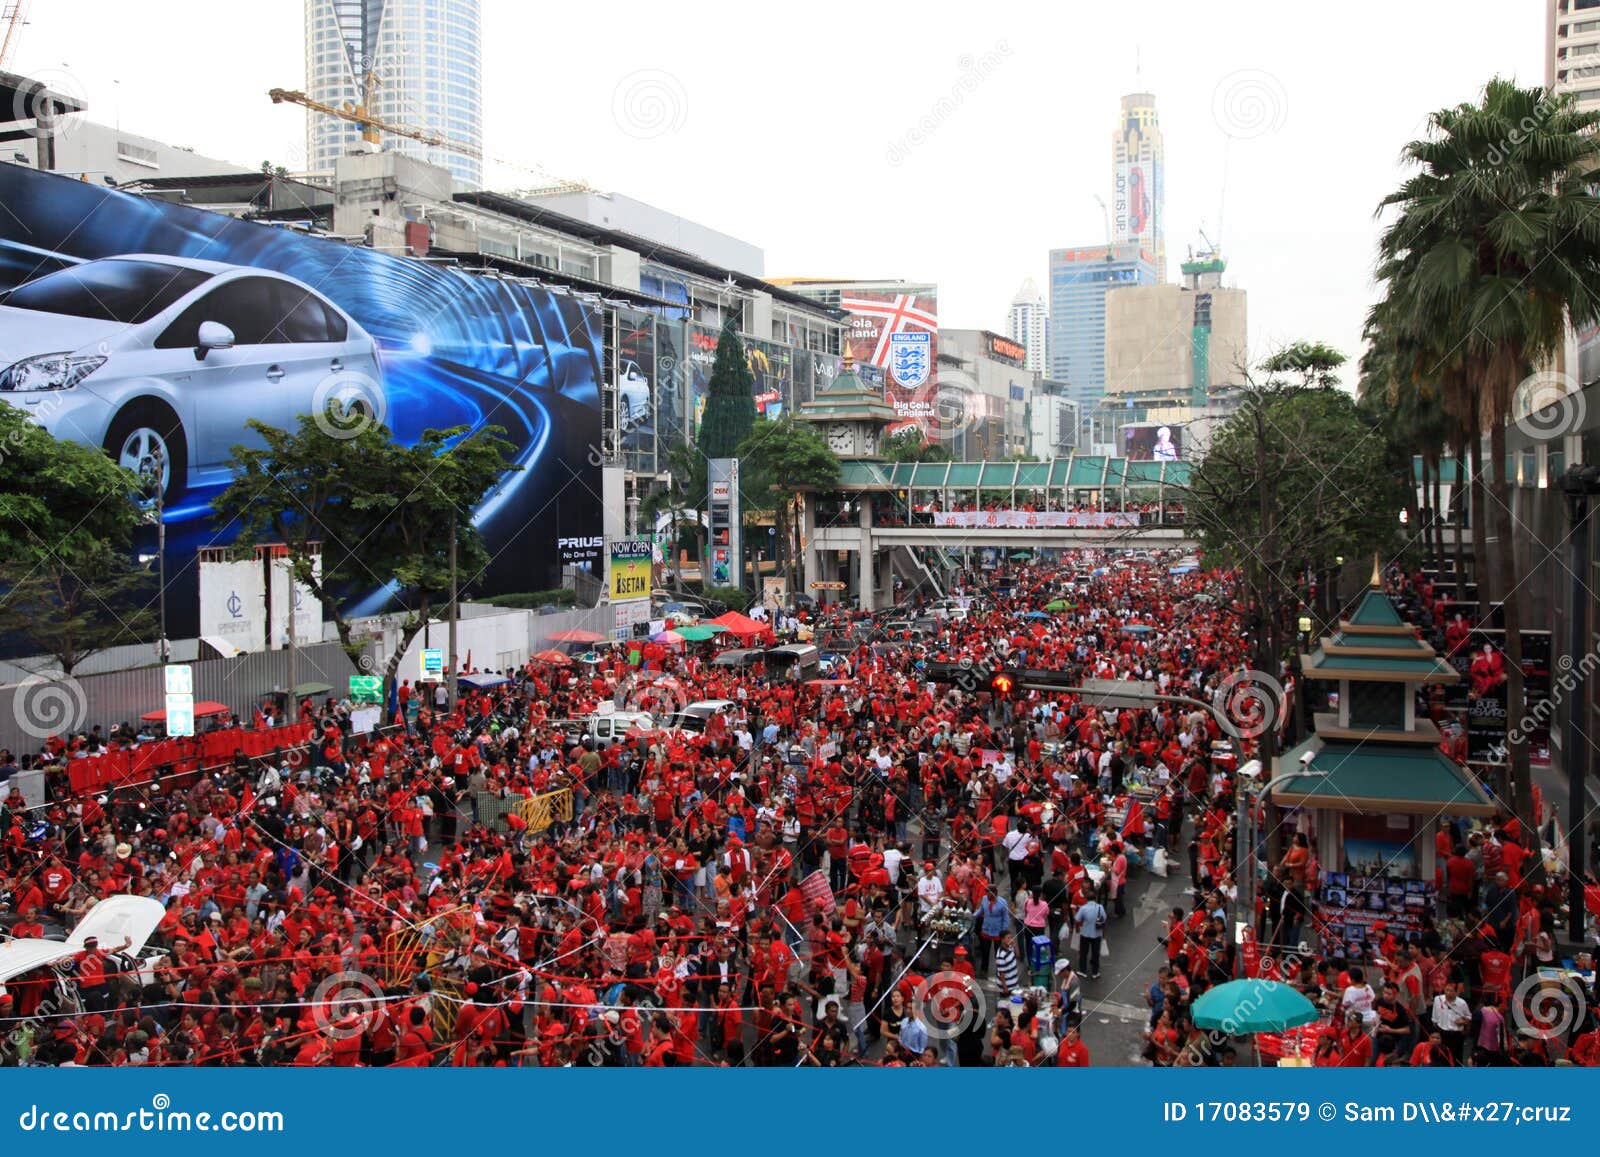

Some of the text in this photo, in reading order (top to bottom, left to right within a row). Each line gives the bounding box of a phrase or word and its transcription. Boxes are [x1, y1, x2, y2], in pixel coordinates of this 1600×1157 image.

[893, 401, 930, 410] Big Cola
[897, 409, 935, 417] England
[713, 487, 729, 495] ZEN
[558, 536, 604, 549] PRIUS
[611, 541, 651, 553] NOW OPEN
[563, 551, 573, 559] No
[573, 550, 586, 558] One
